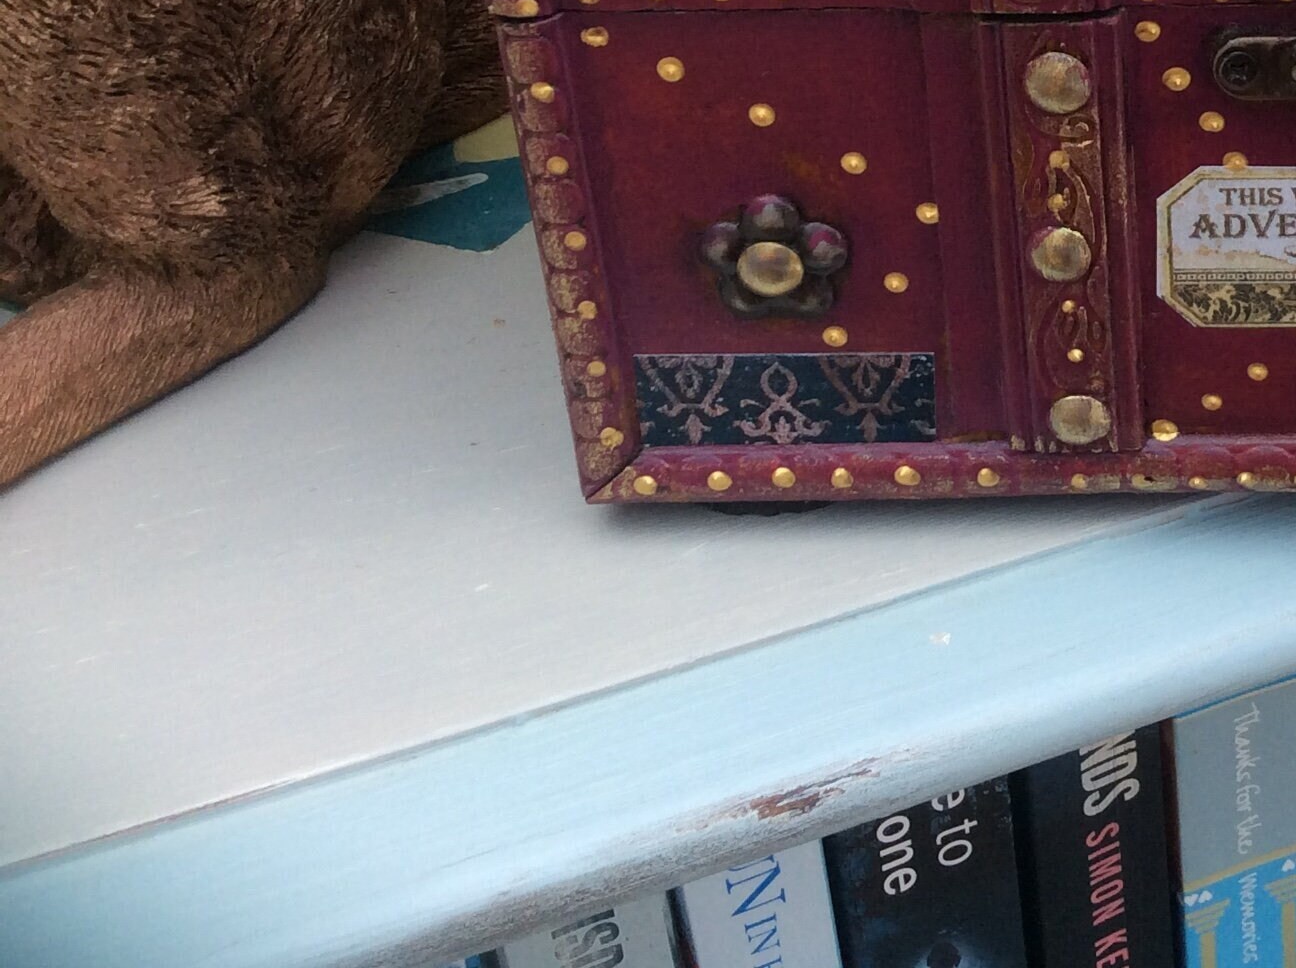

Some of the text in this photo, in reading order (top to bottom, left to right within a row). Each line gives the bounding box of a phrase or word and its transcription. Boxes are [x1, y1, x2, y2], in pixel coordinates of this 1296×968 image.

[1219, 186, 1283, 206] THIS
[1236, 784, 1261, 812] for
[876, 815, 918, 896] one
[936, 818, 978, 867] to
[1086, 821, 1126, 926] SIMON
[1094, 928, 1131, 968] KE
